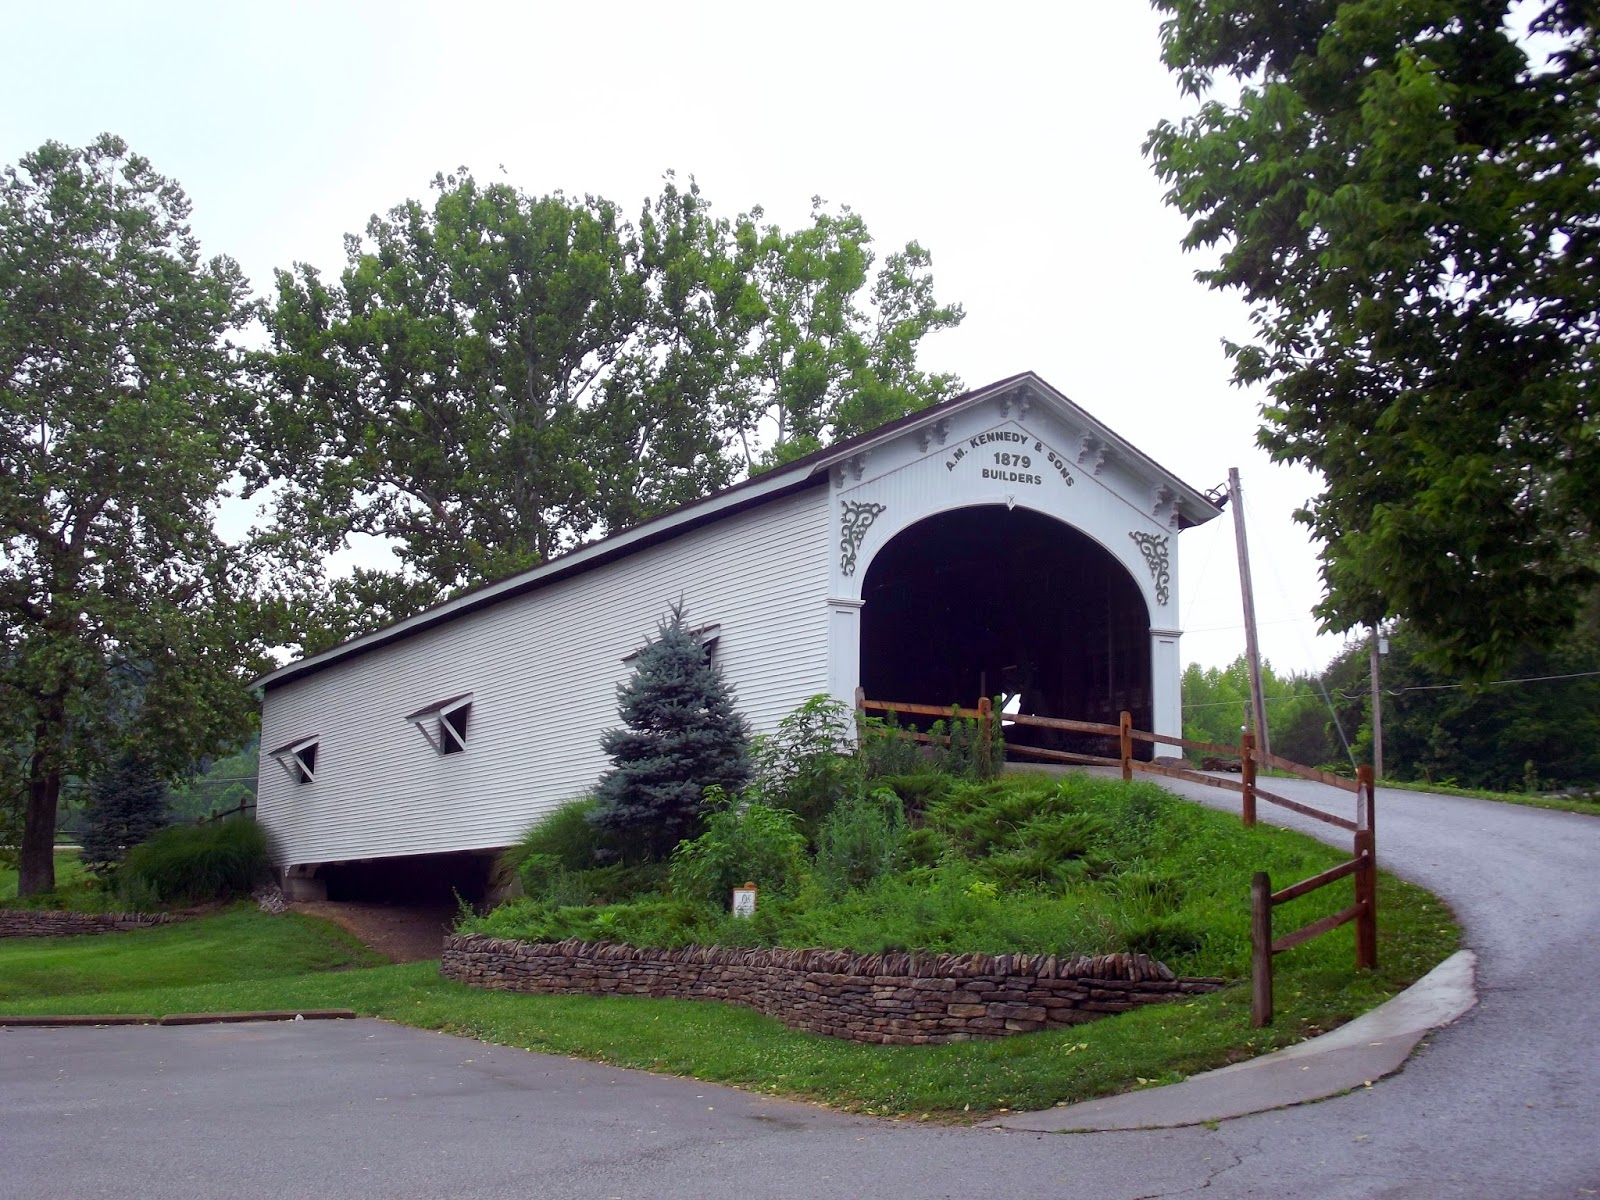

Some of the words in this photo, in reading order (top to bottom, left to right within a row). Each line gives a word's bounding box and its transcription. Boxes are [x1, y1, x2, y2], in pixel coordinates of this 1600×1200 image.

[945, 447, 968, 472] A.M.
[969, 431, 1028, 449] KENNEDY
[1034, 441, 1043, 453] &
[1047, 451, 1075, 487] SONS
[993, 451, 1032, 469] 1879
[982, 468, 1042, 485] BUILDERS
